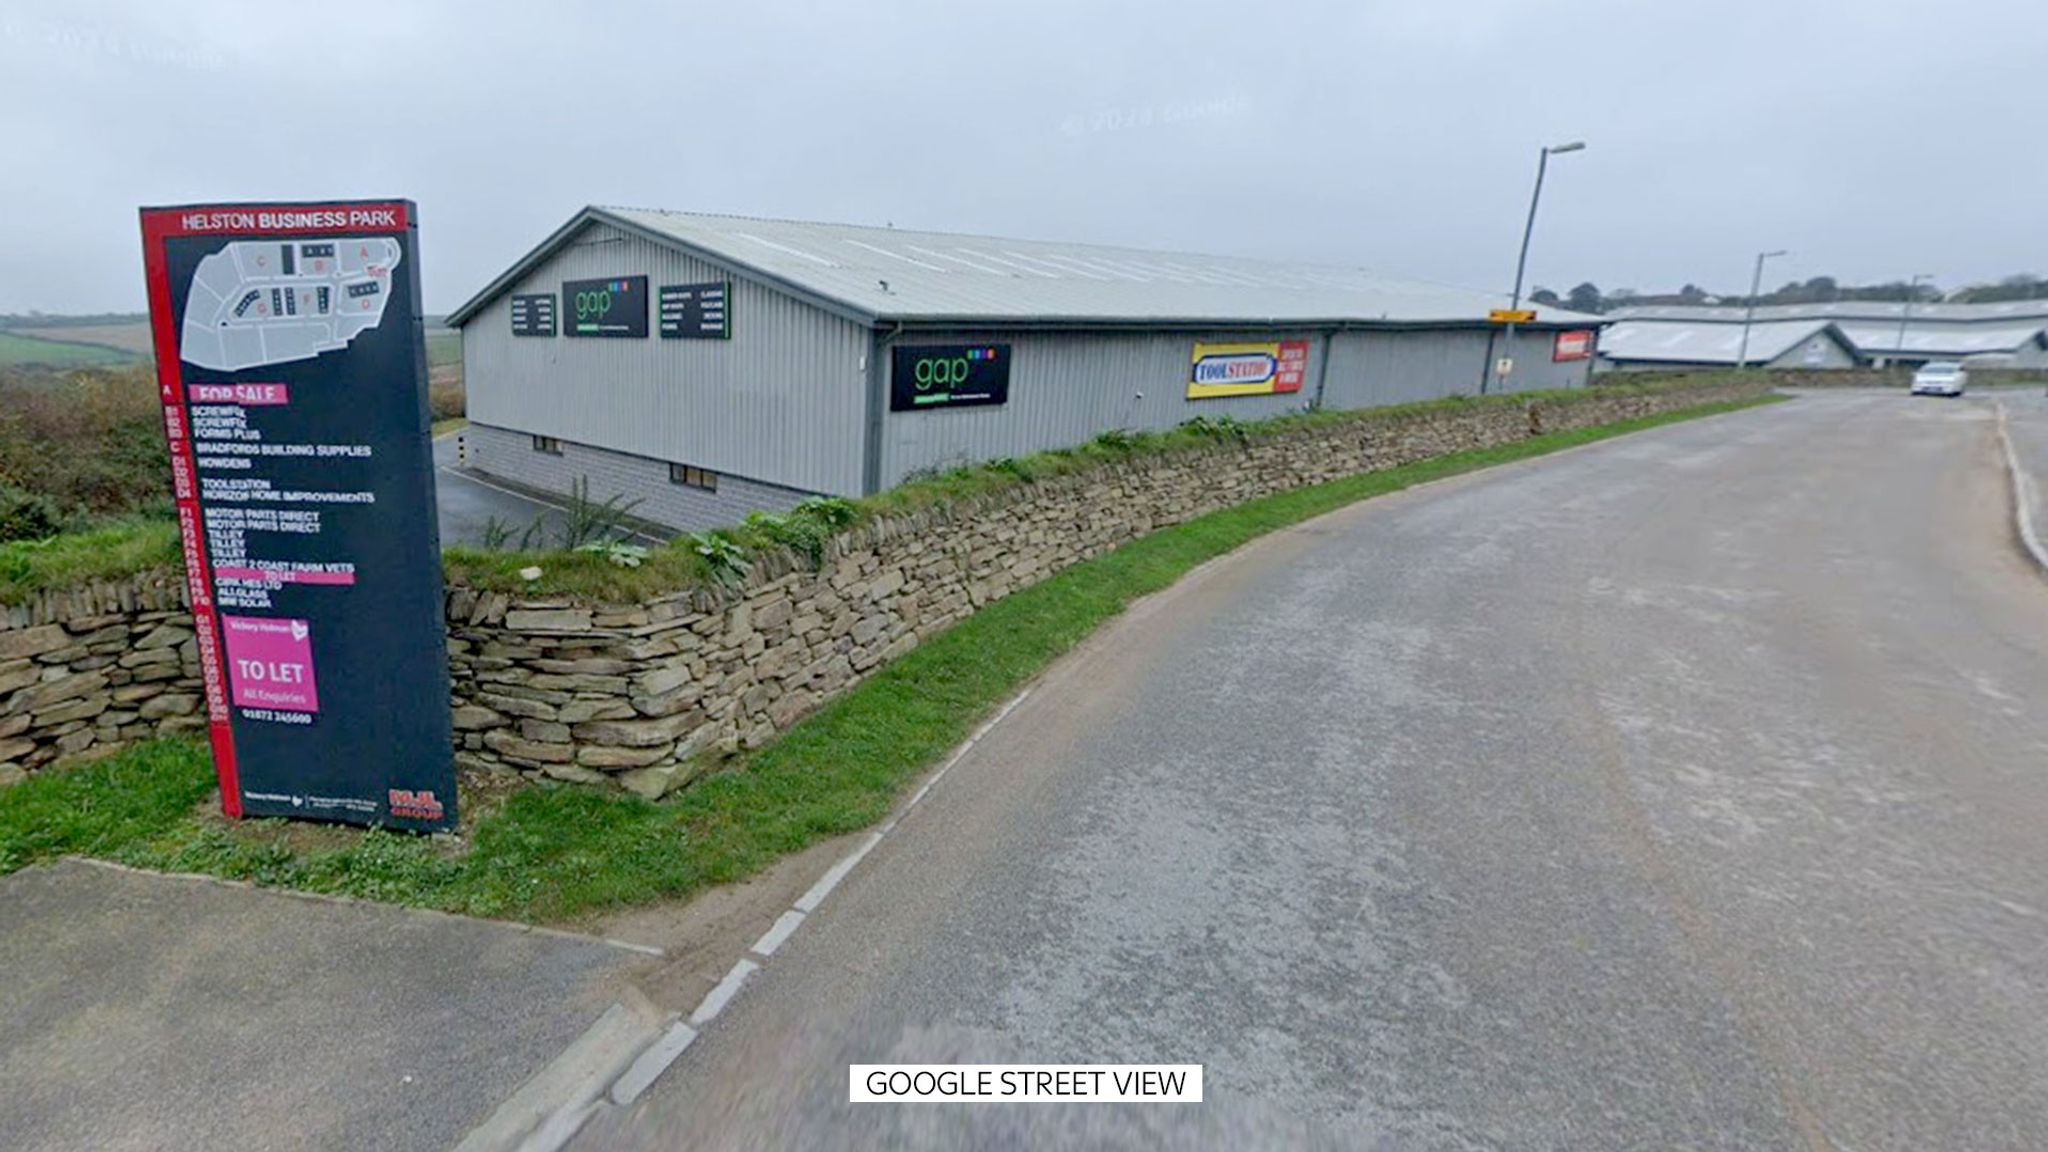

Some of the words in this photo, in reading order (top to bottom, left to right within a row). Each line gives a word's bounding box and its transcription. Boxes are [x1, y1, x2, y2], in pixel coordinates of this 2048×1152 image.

[182, 214, 254, 229] HELSTON
[258, 212, 346, 228] BUSINESS
[351, 210, 396, 226] PARK
[576, 291, 610, 320] gap
[915, 358, 969, 390] gap
[191, 406, 246, 418] SCREWFIX
[193, 417, 247, 429] SCREWFIX
[233, 429, 261, 441] PLUS
[196, 442, 259, 455] BRADFORDS
[261, 444, 314, 456] BUILDING
[316, 445, 372, 457] SUPPLIES
[197, 457, 252, 469] HOWDENS
[201, 478, 271, 490] TOOLSTATION
[251, 490, 281, 502] HOME
[283, 491, 375, 504] IMPROVEMENTS
[205, 508, 245, 519] MOTOR
[245, 509, 278, 520] PARTS
[279, 510, 320, 522] DIRECT
[207, 519, 246, 530] MOTOR
[247, 520, 278, 531] PARTS
[280, 521, 320, 533] DIRECT
[208, 529, 244, 540] TILLEY
[209, 539, 245, 550] TILLEY
[212, 559, 247, 569] COAST
[249, 559, 256, 569] 2
[257, 560, 290, 571] COAST
[325, 562, 355, 574] VETS
[237, 659, 265, 681] TO
[269, 662, 304, 684] LET
[259, 690, 307, 705] Enquiries
